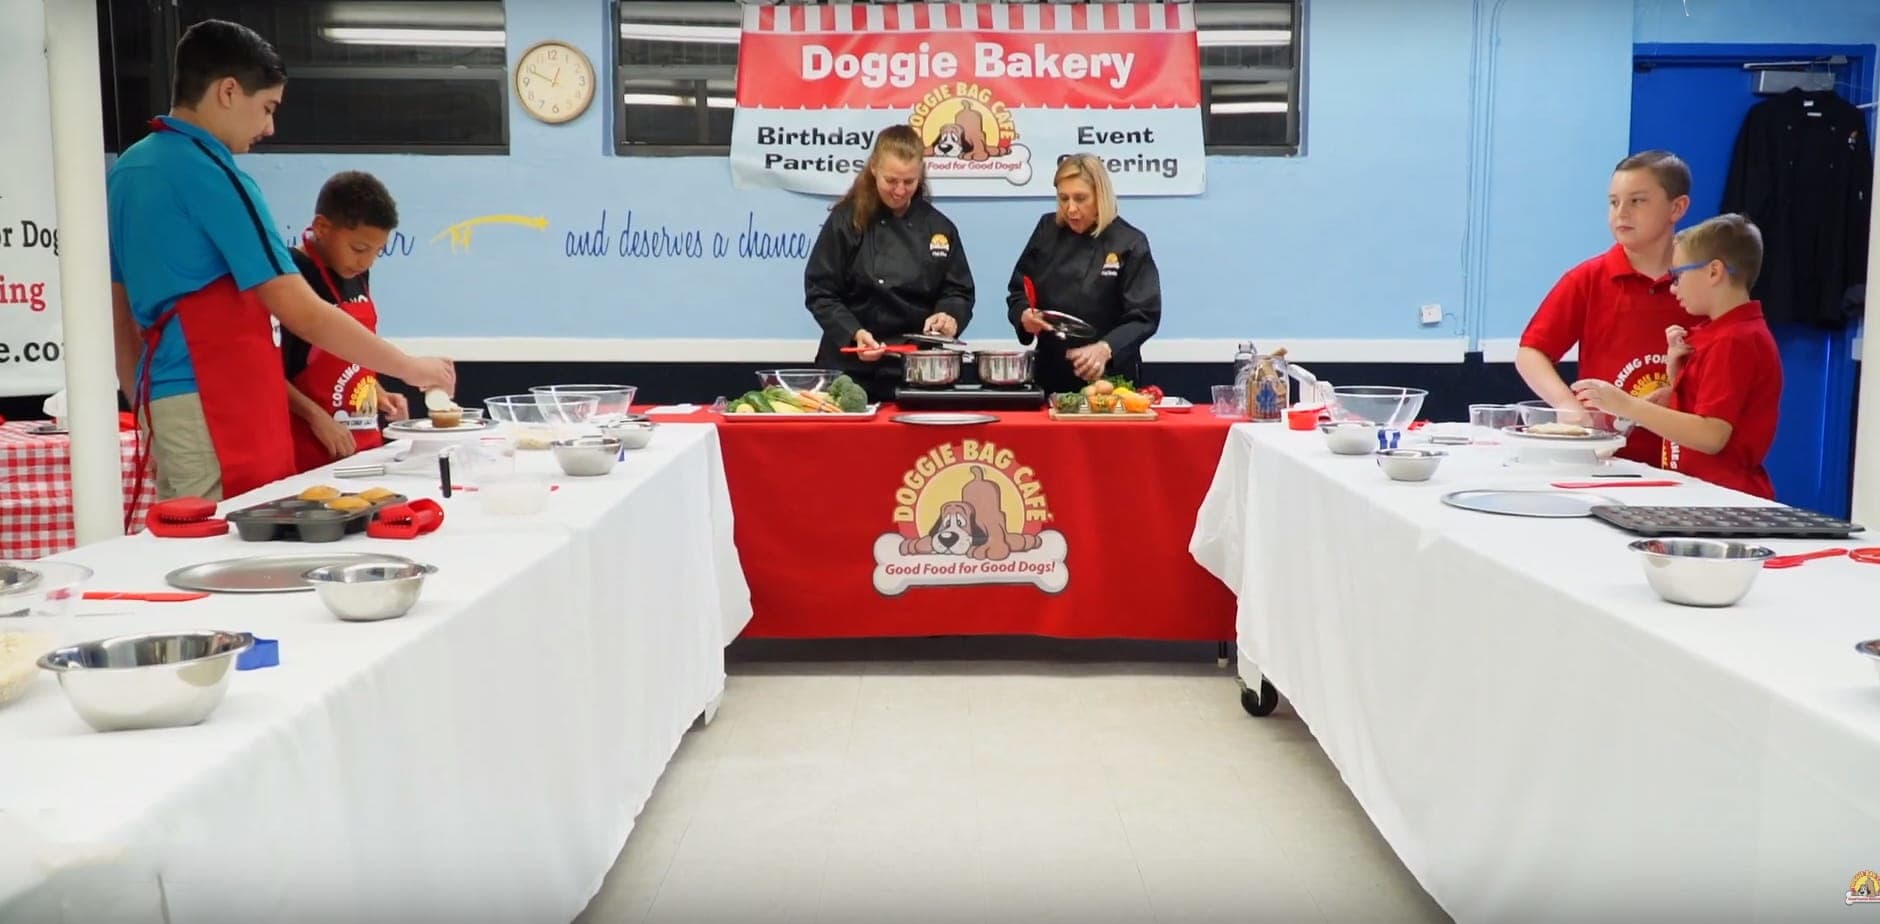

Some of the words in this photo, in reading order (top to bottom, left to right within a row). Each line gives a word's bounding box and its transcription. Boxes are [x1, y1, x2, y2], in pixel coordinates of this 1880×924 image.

[802, 42, 957, 88] Doggie
[975, 42, 1135, 89] Bakery
[956, 82, 992, 101] BAG
[757, 126, 874, 150] Birthday
[1077, 126, 1155, 145] Event
[765, 153, 865, 173] Parties
[927, 162, 951, 170] Food
[953, 162, 966, 171] for
[968, 161, 992, 170] Good
[995, 161, 1022, 172] Dogs!
[1057, 154, 1179, 178] ering
[566, 209, 609, 258] and
[619, 210, 702, 258] deserves
[713, 231, 729, 258] a
[739, 211, 811, 260] chance
[0, 341, 65, 363] e.co
[1614, 358, 1642, 387] OKING
[332, 363, 360, 407] COOKING
[893, 442, 957, 523] DOGGIE
[962, 439, 1014, 470] BAG
[1013, 466, 1053, 523] CAFÉ
[885, 563, 921, 575] Good
[923, 563, 955, 575] Food
[959, 562, 978, 574] for
[980, 561, 1016, 573] Good
[1018, 561, 1055, 575] Dogs!
